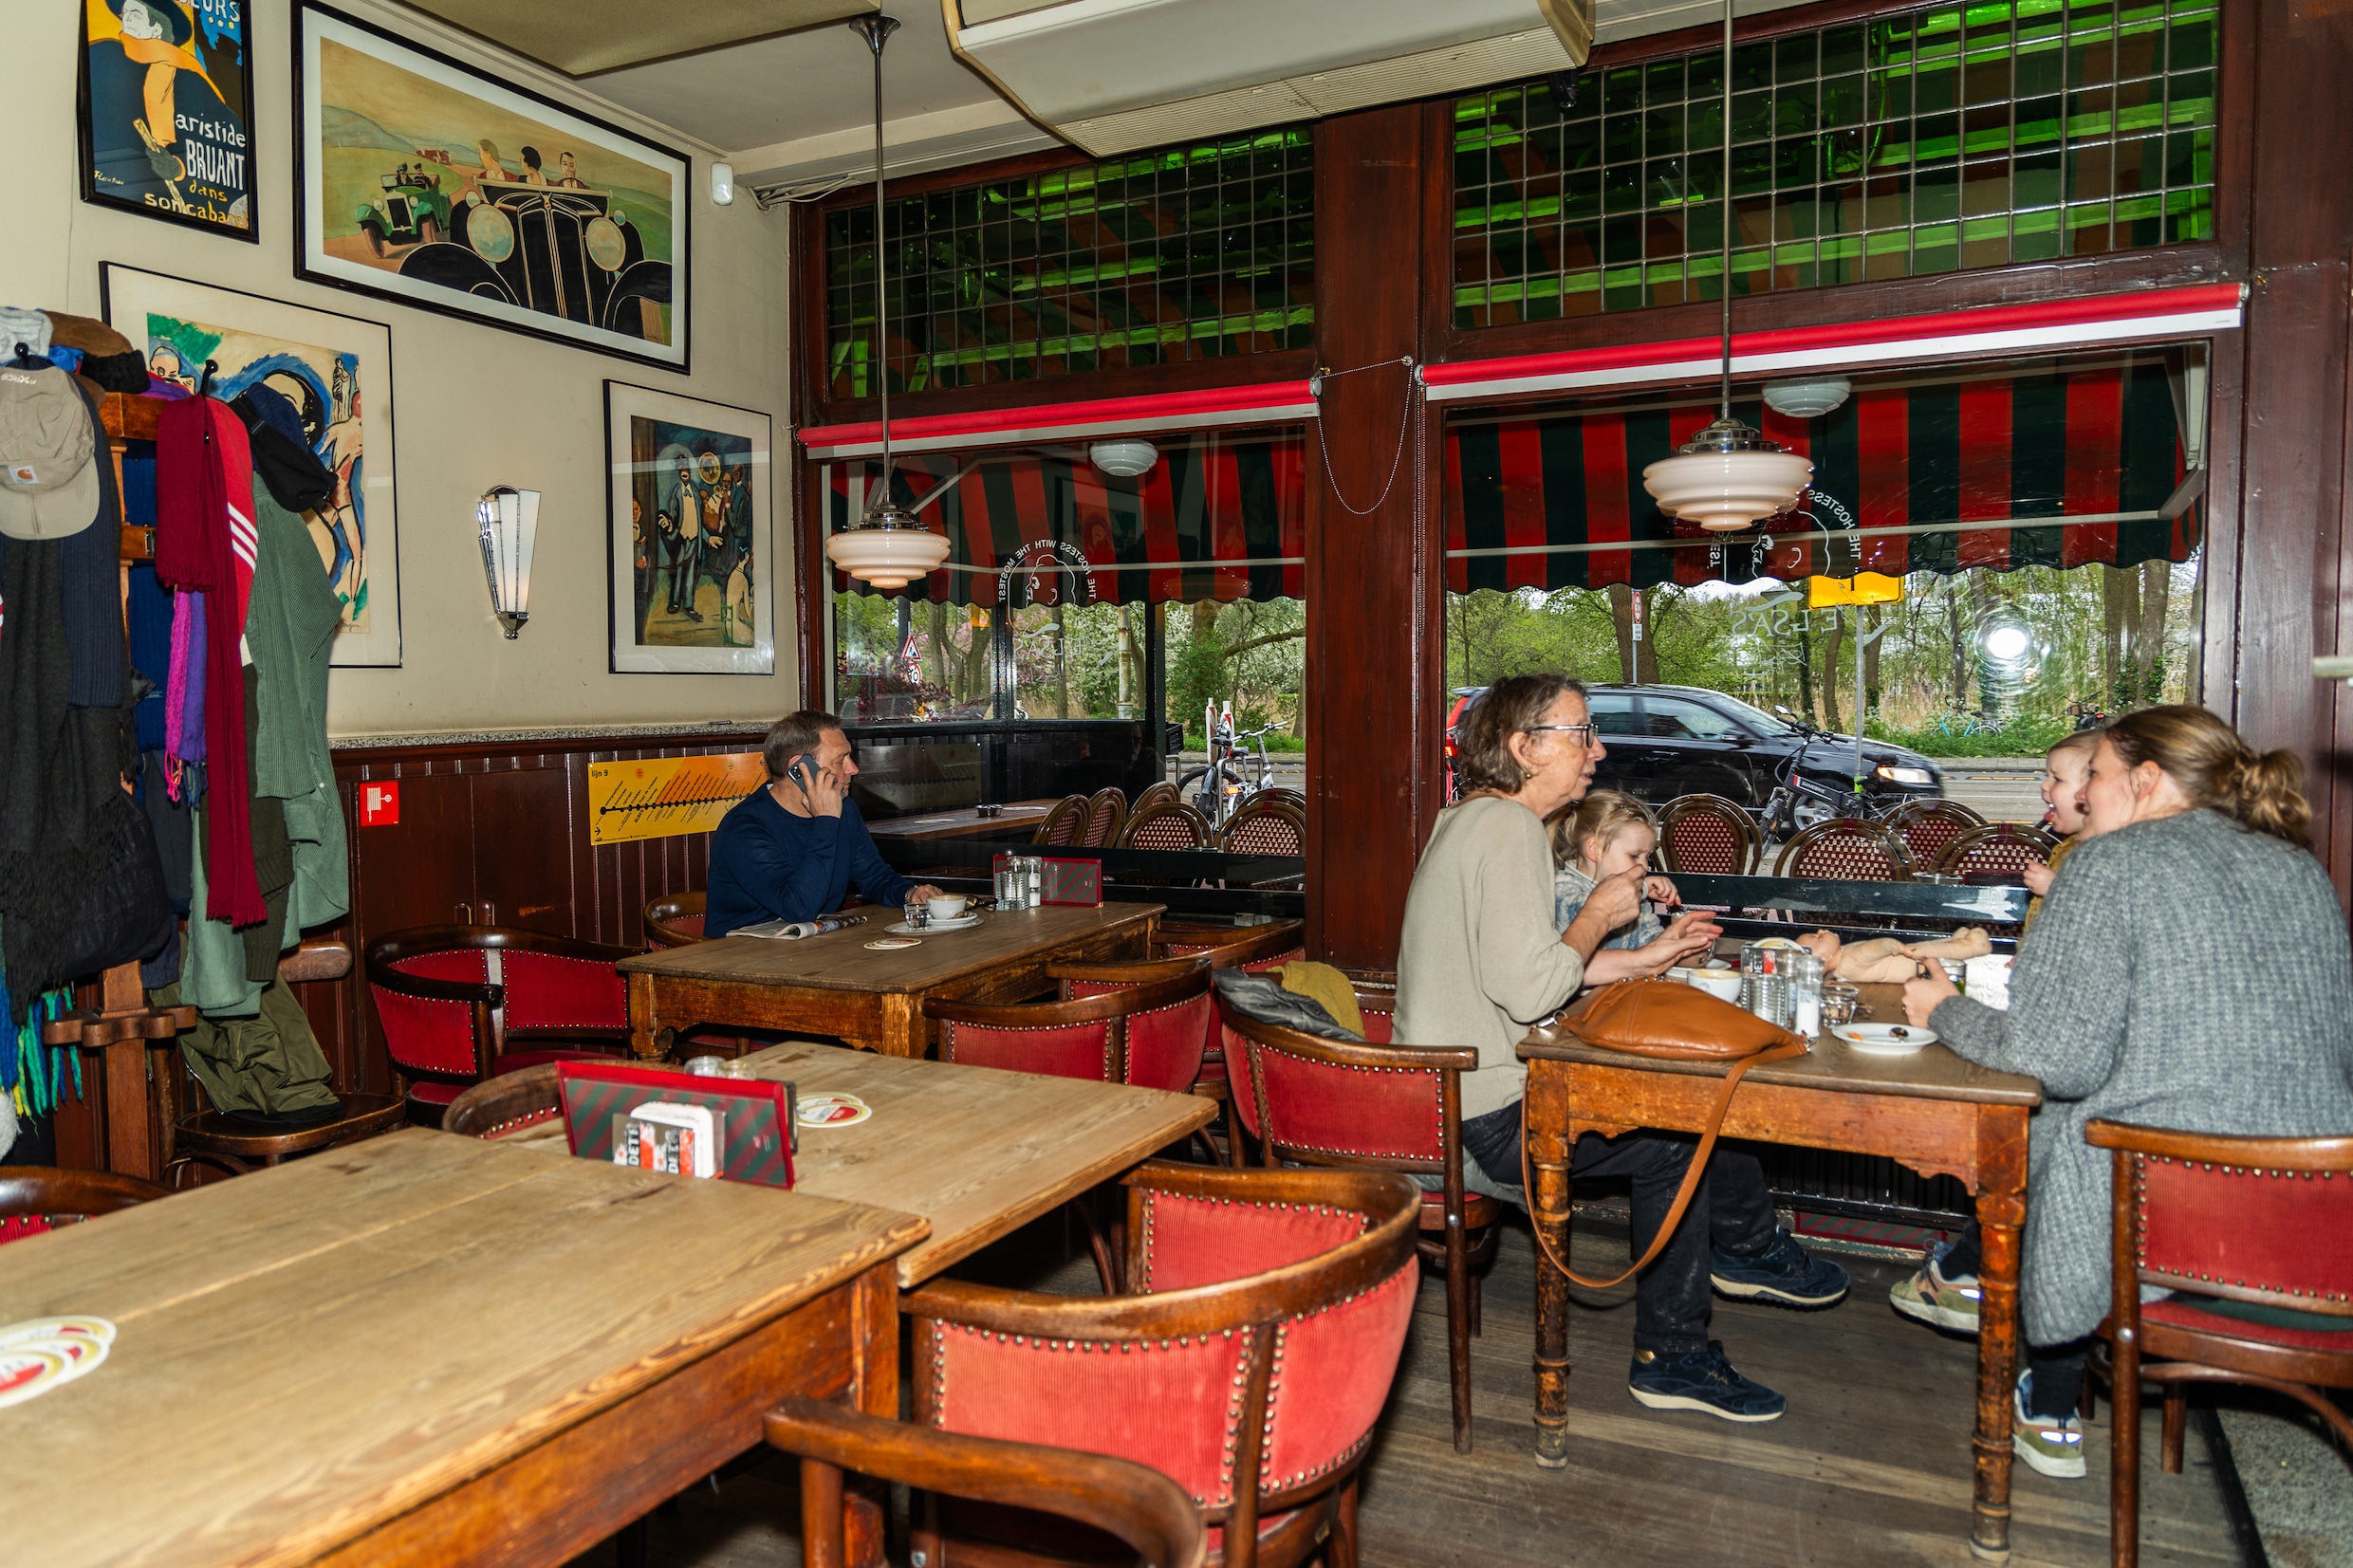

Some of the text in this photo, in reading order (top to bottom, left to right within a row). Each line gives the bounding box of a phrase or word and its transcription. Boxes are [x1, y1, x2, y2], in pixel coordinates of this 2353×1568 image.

[175, 113, 247, 148] aristide
[185, 138, 246, 190] BRUANT
[189, 180, 228, 202] dans
[144, 193, 249, 230] son cabaret
[592, 768, 609, 778] lijn 9
